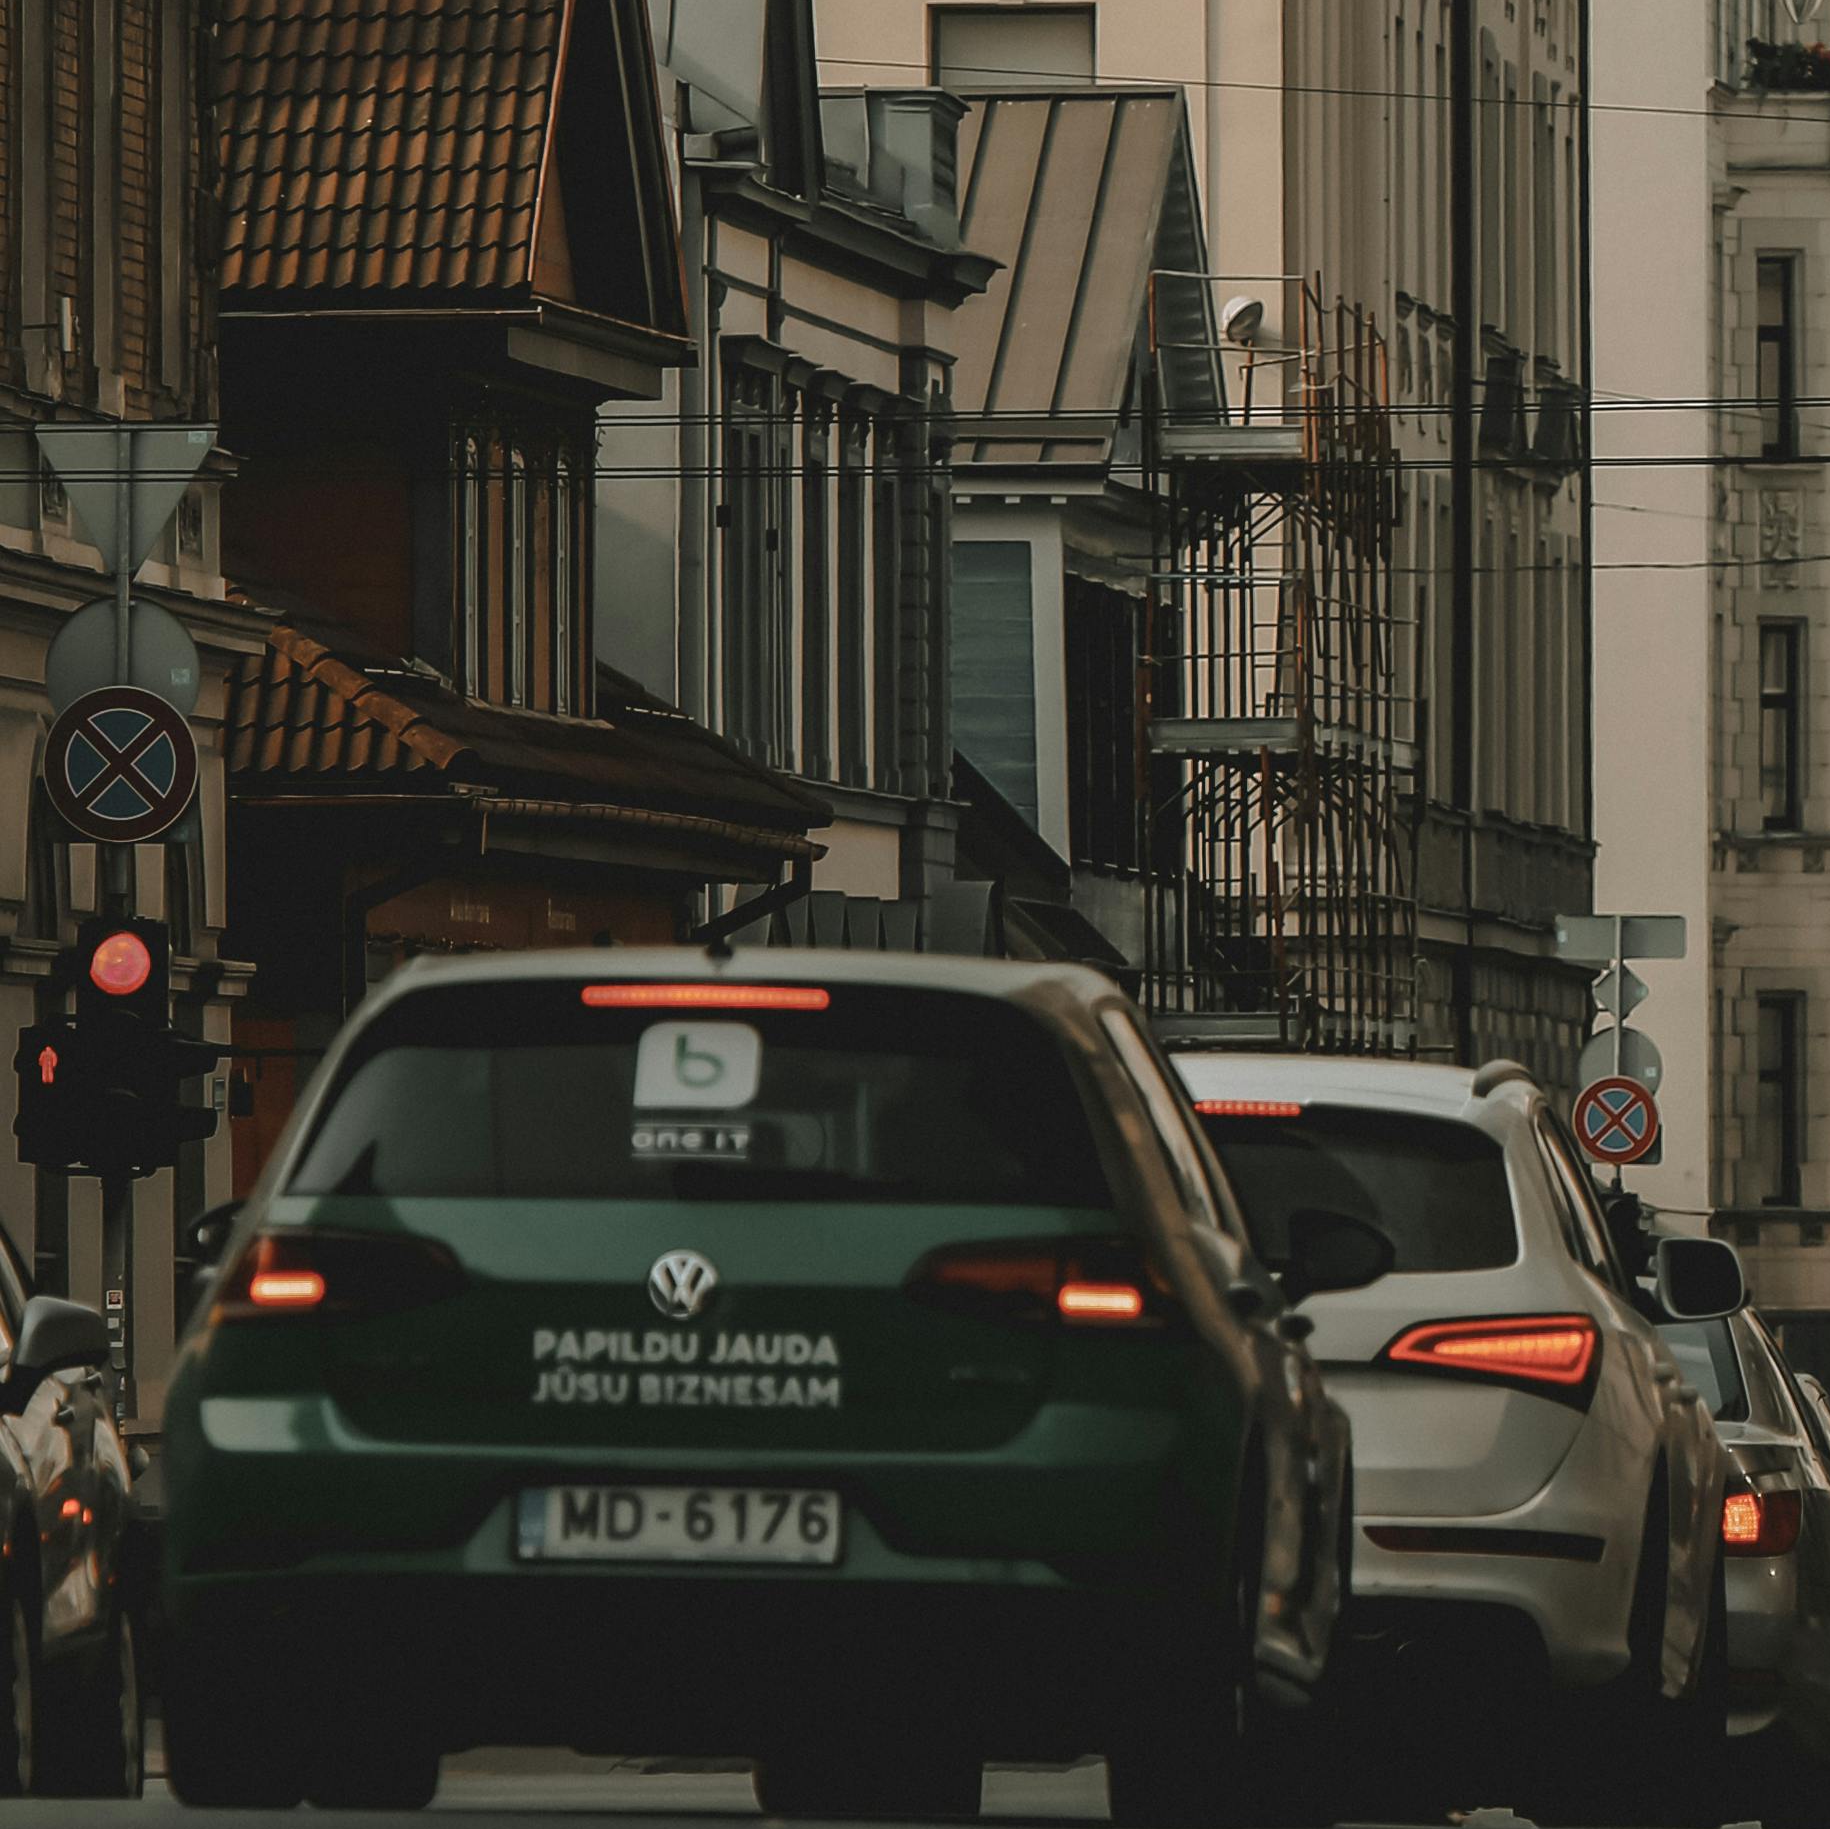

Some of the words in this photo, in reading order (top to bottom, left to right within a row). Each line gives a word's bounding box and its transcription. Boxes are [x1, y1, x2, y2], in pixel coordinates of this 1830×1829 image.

[533, 1330, 698, 1363] PAPILDU
[709, 1332, 838, 1365] JAUDA
[639, 1373, 840, 1408] BIZNESAM
[560, 1489, 830, 1544] MD-6176
